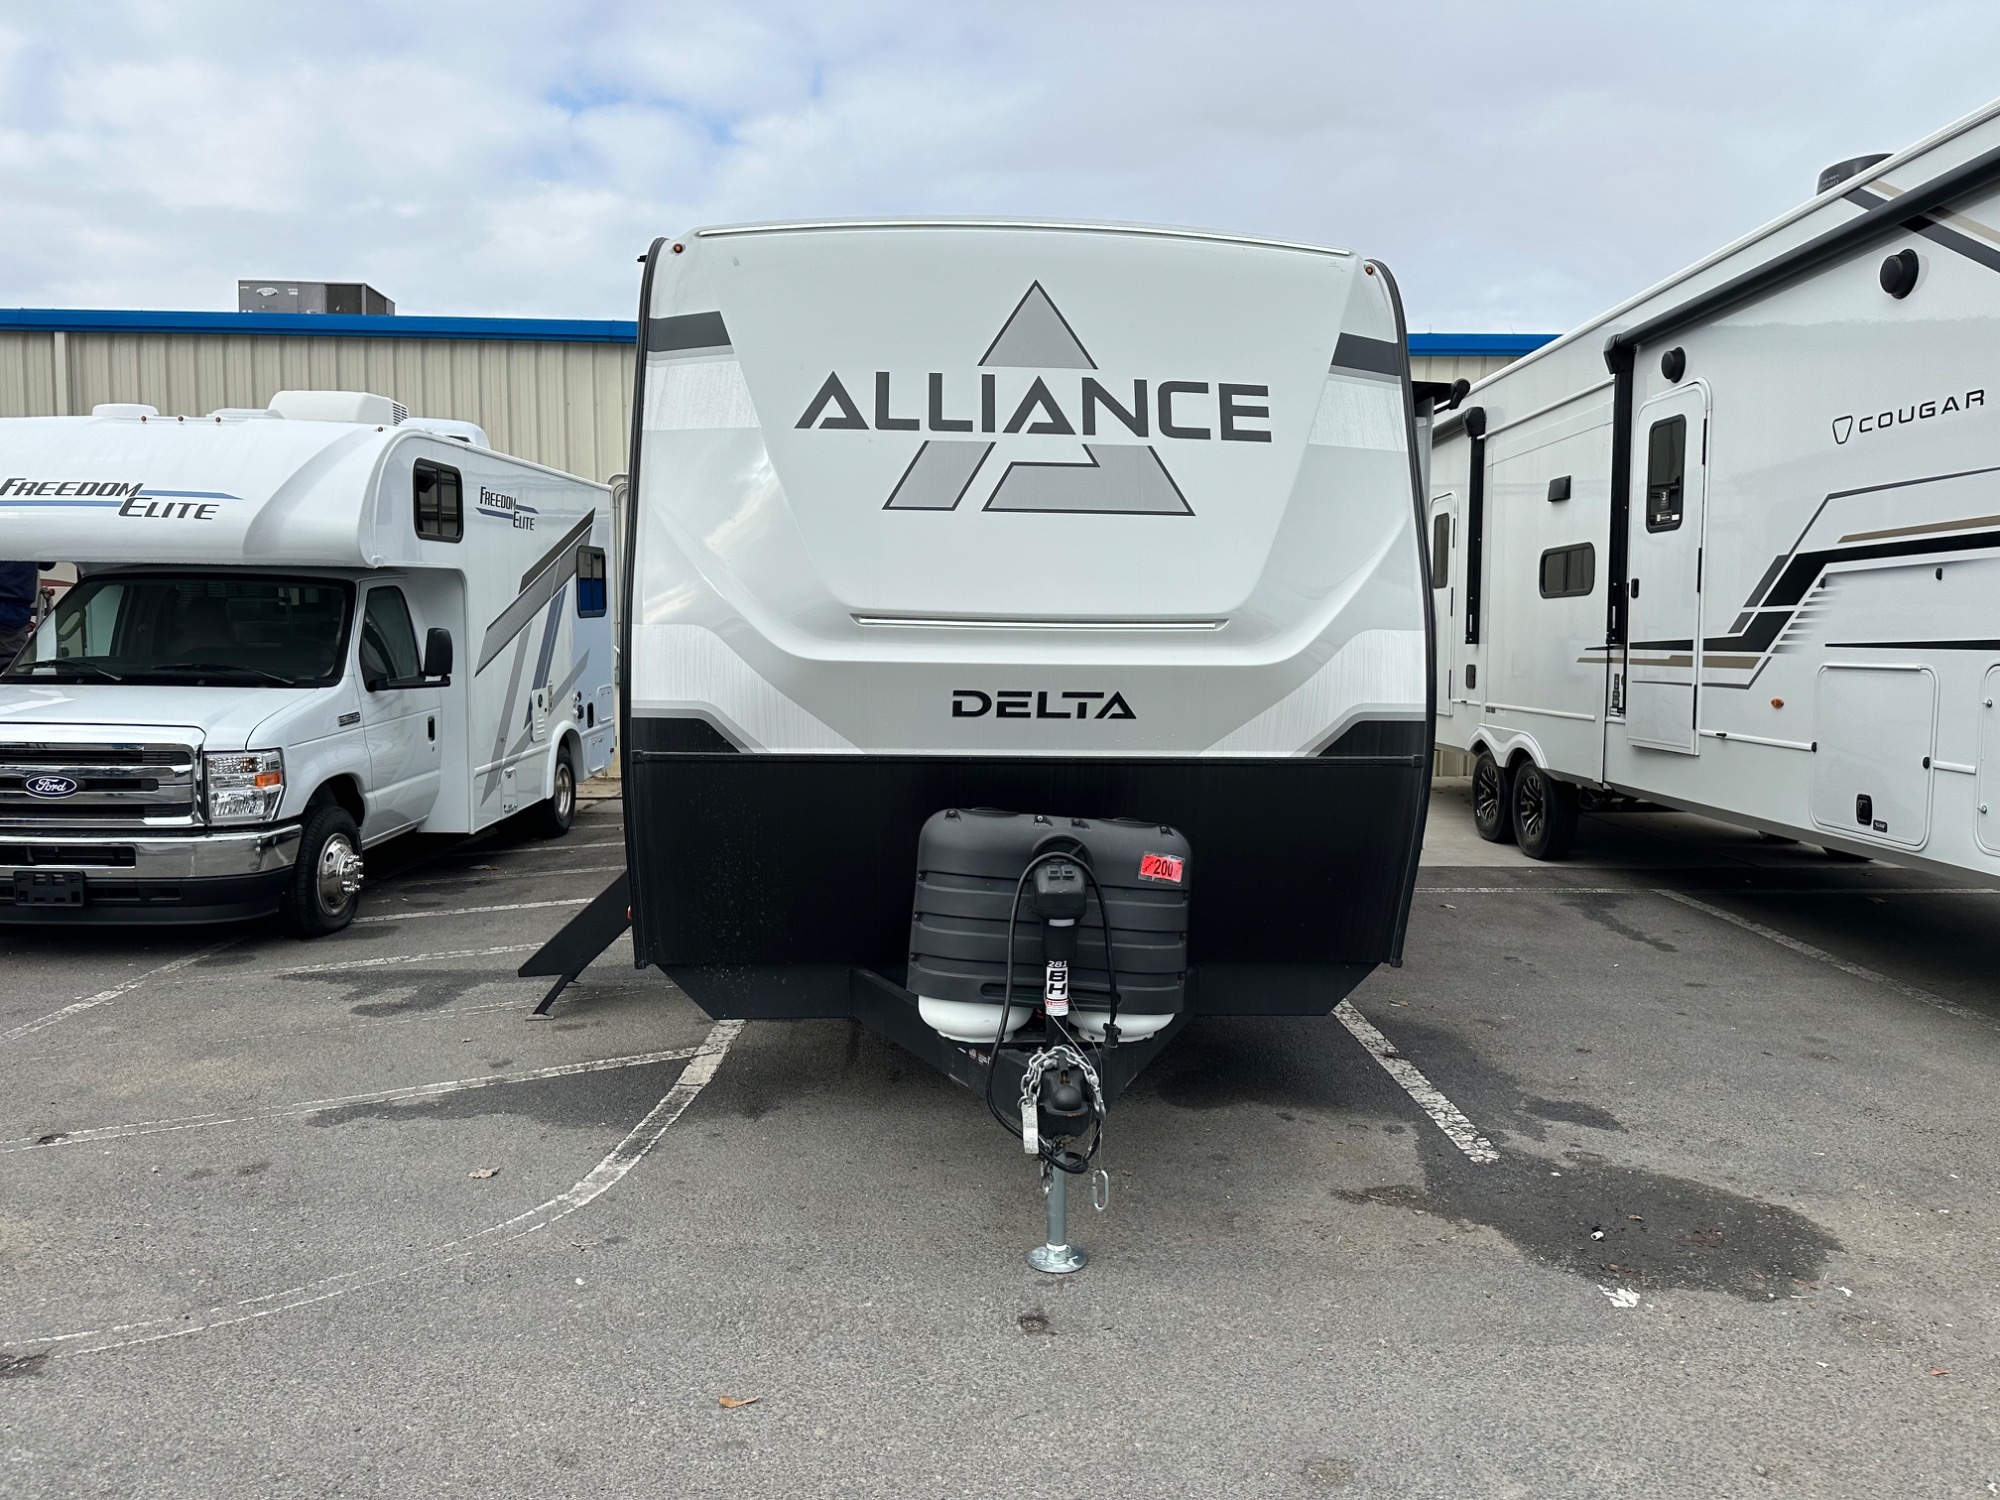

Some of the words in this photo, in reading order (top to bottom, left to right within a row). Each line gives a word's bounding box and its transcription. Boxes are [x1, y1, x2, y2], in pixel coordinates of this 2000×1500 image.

[794, 371, 1272, 443] ALLIANCE
[1858, 389, 1985, 433] COUGAR
[0, 477, 144, 497] FREEDOM
[480, 485, 517, 511] FREEDOM
[118, 497, 220, 520] ELITE
[512, 510, 535, 531] ELITE
[951, 689, 1137, 720] DELTA
[35, 778, 68, 792] Ford
[1153, 858, 1174, 877] 200
[1047, 960, 1068, 968] 281
